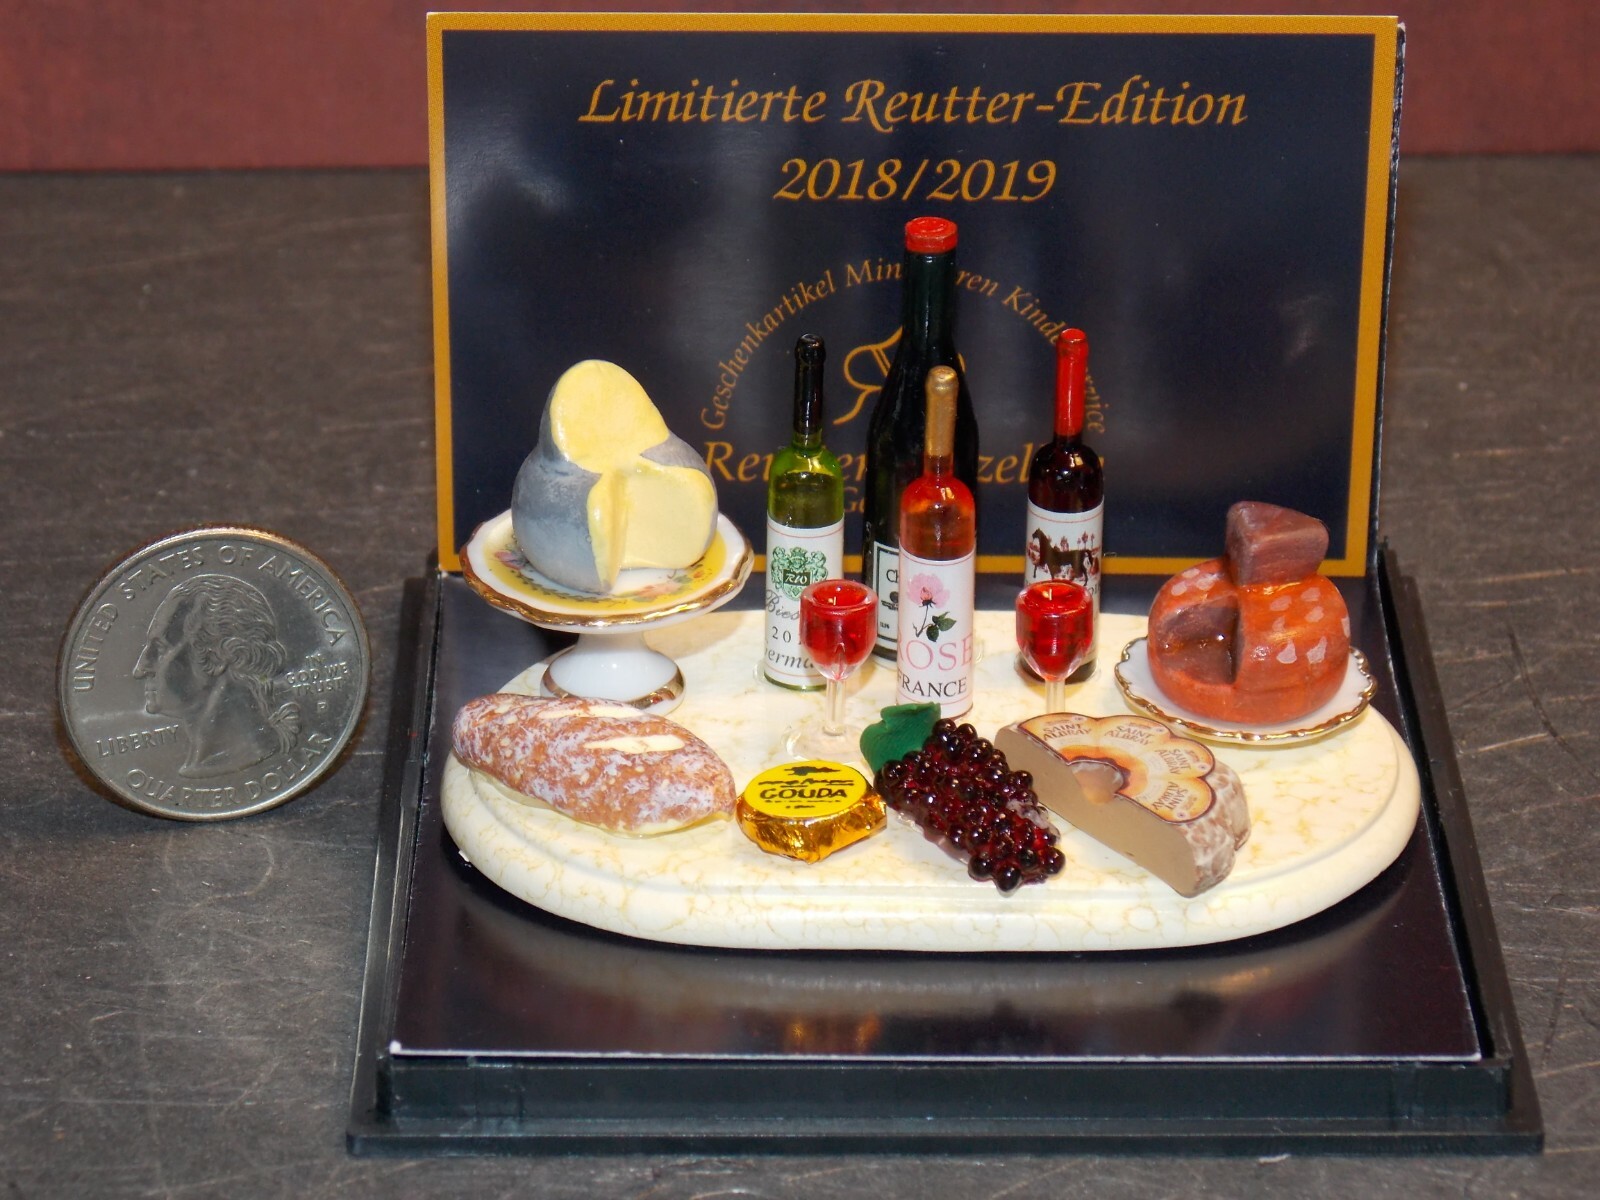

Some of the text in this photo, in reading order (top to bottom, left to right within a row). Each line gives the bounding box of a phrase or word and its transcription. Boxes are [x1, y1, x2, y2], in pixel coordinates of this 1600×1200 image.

[578, 75, 1248, 133] Limitierte Reutter-Edition
[773, 157, 1057, 202] 2018/2019
[701, 269, 837, 430] Geschenkartikel
[845, 257, 999, 298] Minren
[74, 545, 348, 692] UNITED STATES OF AMERICA
[286, 661, 348, 685] GOD WE
[305, 653, 326, 667] IN
[292, 676, 344, 696] TRUST
[96, 724, 179, 759] LIBERTY
[1042, 723, 1085, 734] SAINT
[1116, 725, 1154, 738] SAINT
[126, 733, 333, 808] QUARTER DOLLAR
[760, 788, 848, 799] GOUDA
